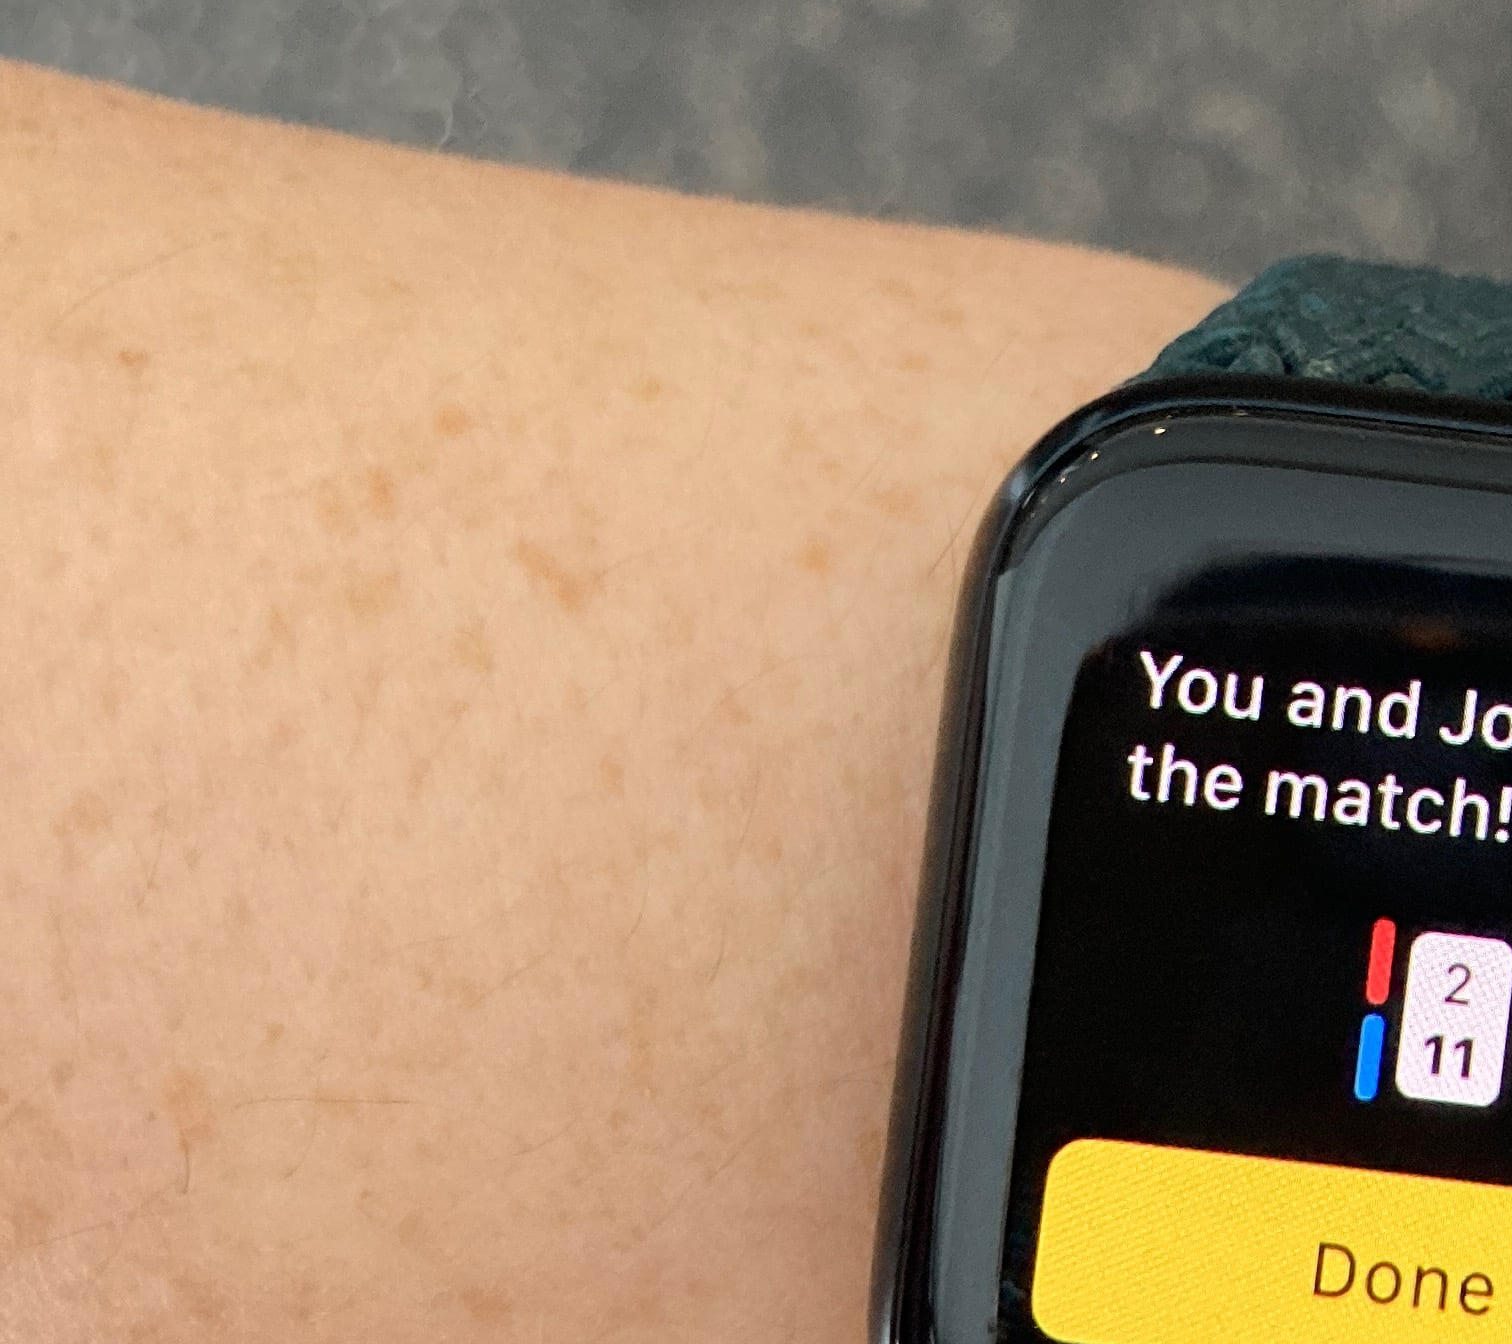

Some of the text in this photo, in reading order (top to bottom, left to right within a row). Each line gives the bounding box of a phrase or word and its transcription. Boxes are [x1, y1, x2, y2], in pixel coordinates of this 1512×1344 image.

[1139, 650, 1264, 721] You
[1287, 679, 1422, 740] and
[1127, 742, 1244, 811] the
[1444, 962, 1472, 1006] 2
[1423, 1034, 1475, 1080] 11
[1312, 1240, 1496, 1317] Done
